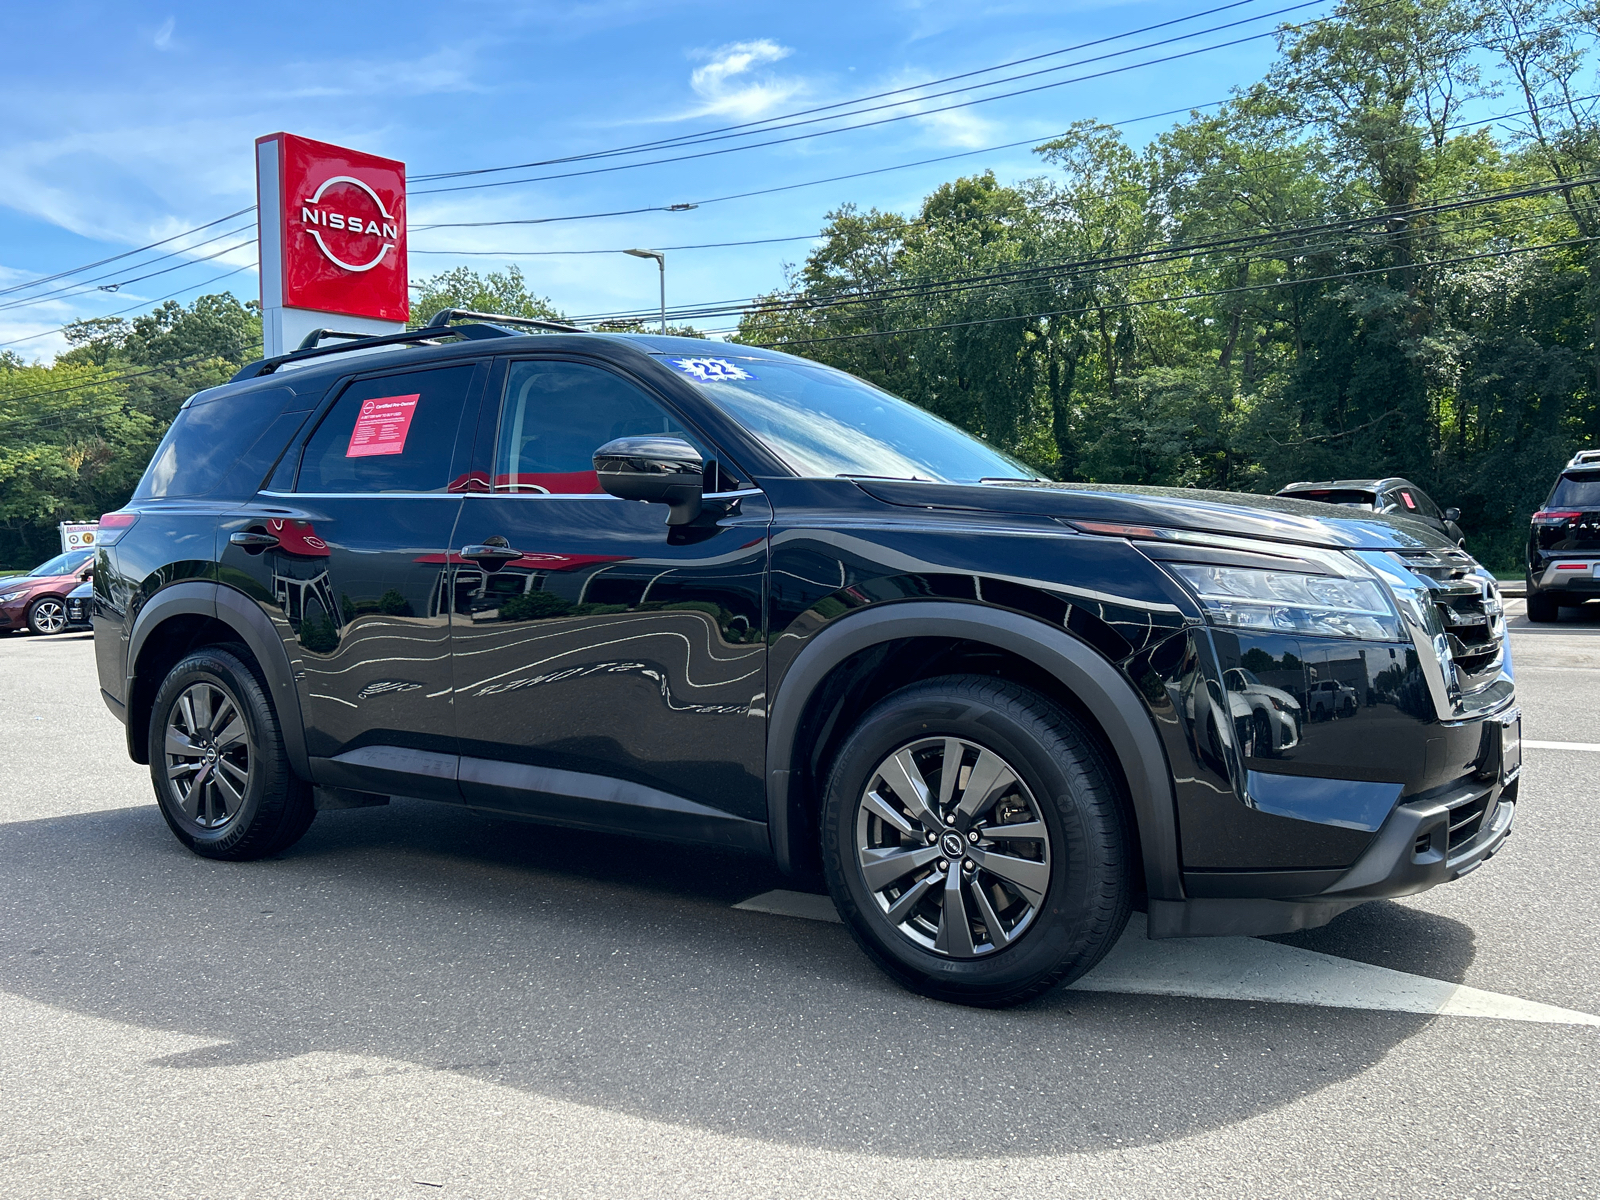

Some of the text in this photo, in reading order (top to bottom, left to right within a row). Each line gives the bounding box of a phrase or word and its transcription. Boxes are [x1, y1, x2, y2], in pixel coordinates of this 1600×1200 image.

[302, 207, 397, 239] NISSAN
[692, 362, 736, 376] 22
[825, 743, 858, 920] VELOCITY CROSS
